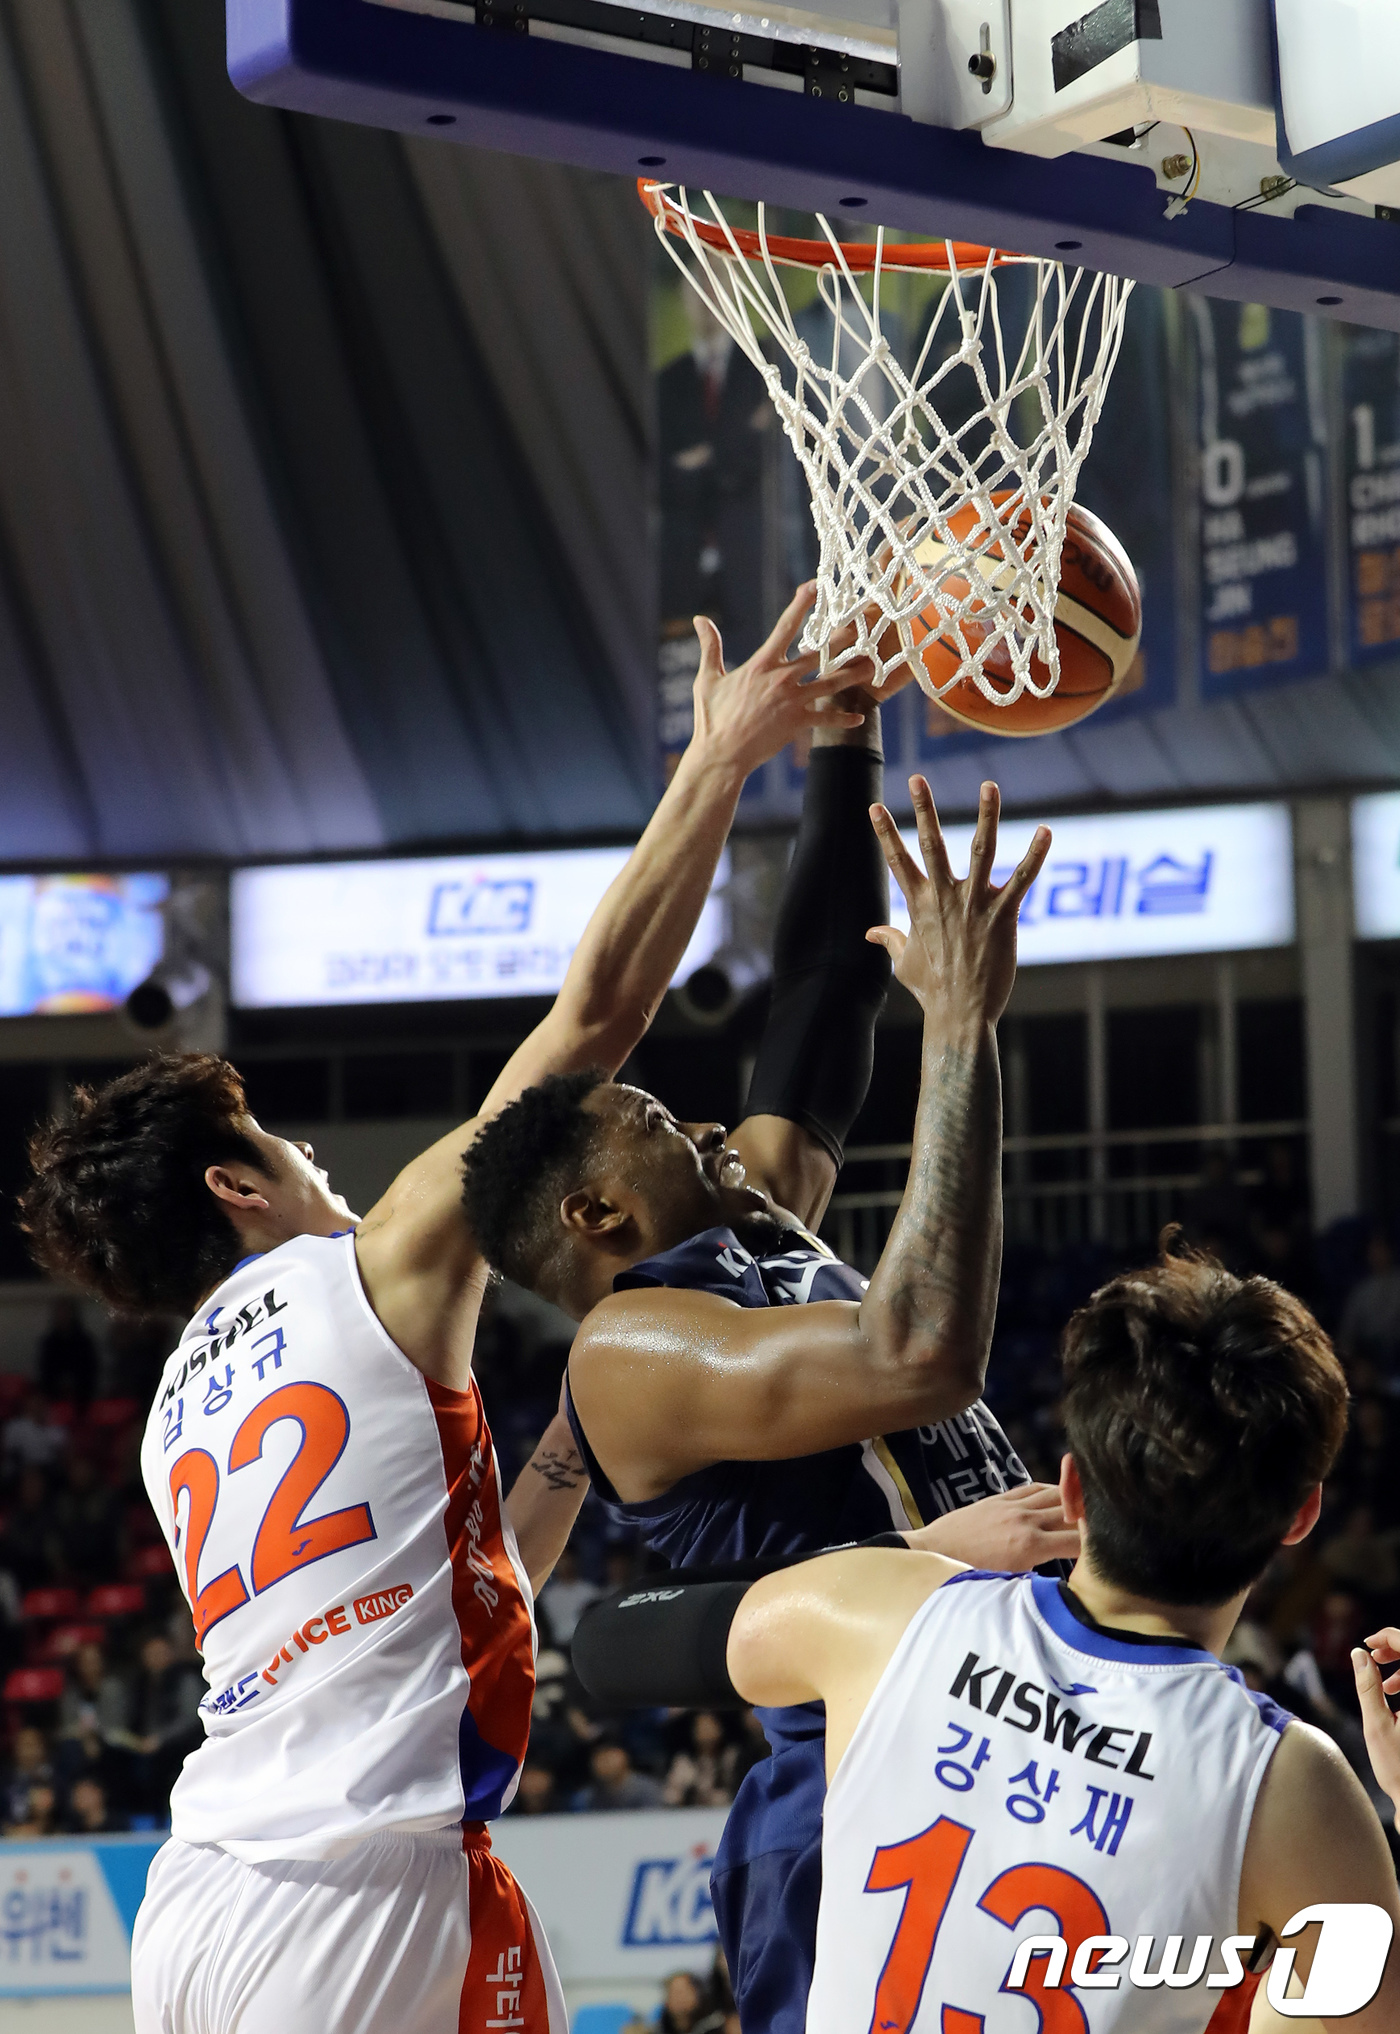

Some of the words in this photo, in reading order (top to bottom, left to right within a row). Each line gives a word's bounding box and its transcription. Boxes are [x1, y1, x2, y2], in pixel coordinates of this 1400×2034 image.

[1204, 438, 1245, 507] 0
[158, 1287, 289, 1413] KISWEL
[161, 1326, 288, 1455] 김상규
[168, 1381, 378, 1652] 22
[948, 1651, 1156, 1782] KISWEL
[933, 1721, 1135, 1857] 강상재
[862, 1813, 1112, 2034] 13
[485, 1945, 525, 2034] 닥터
